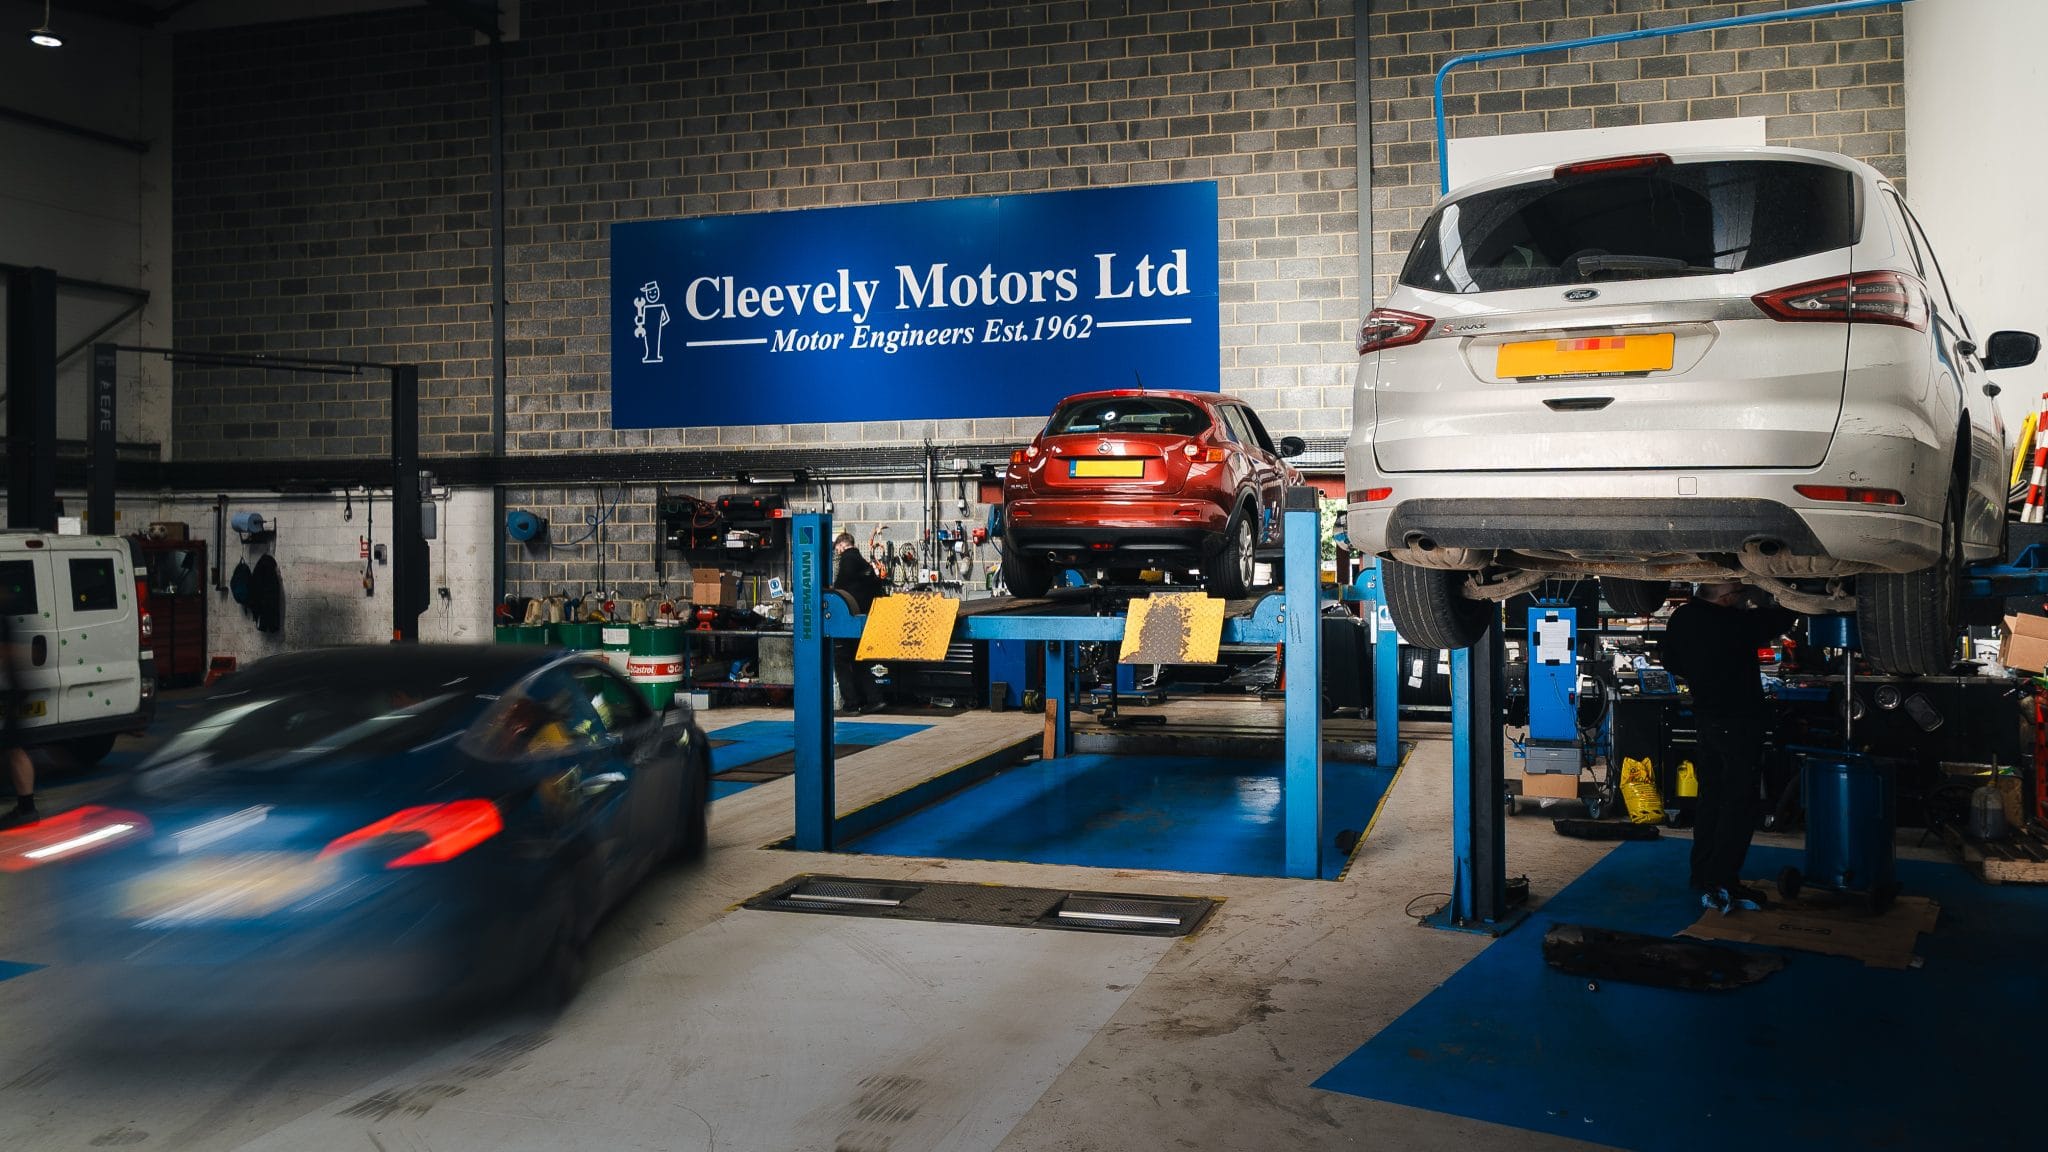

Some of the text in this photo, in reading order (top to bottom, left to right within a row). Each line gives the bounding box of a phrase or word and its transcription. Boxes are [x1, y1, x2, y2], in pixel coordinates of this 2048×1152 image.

[685, 248, 1191, 324] Cleevely Motors Ltd
[1569, 290, 1592, 299] Ford
[770, 313, 1093, 355] Motor Engineers Est.1962
[802, 551, 812, 640] HOFMANN
[632, 664, 654, 674] Castrol
